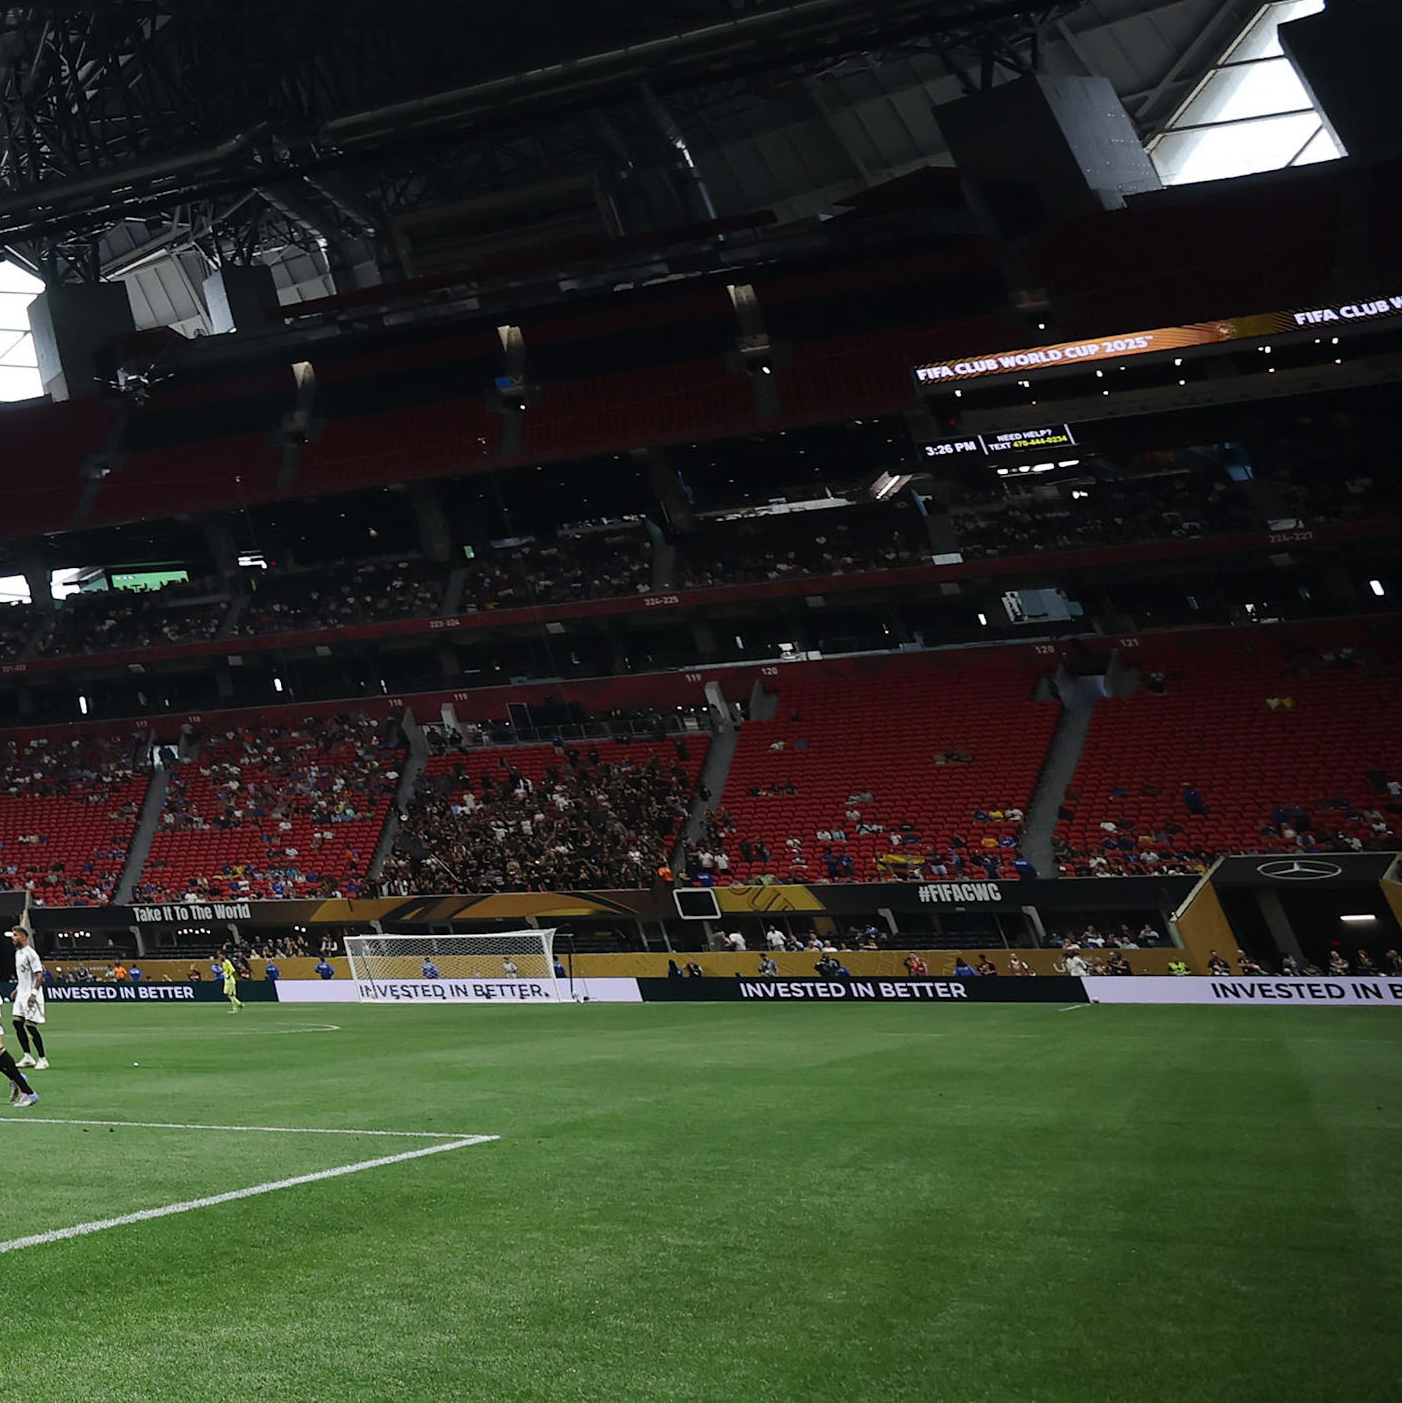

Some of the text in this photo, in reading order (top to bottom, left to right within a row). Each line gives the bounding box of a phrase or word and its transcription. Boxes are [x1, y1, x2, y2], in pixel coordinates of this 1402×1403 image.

[1294, 309, 1338, 324] FIFA
[1339, 300, 1389, 317] CLUB
[916, 365, 953, 379] FIFA
[954, 359, 997, 374] CLUB
[998, 349, 1062, 367] WORLD
[1063, 343, 1100, 358] CUP
[925, 441, 977, 456] 3:26 PM
[919, 883, 1000, 901] #FIFACWC
[133, 902, 252, 922] Take It To The World
[47, 986, 193, 999] INVESTED IN BETTER
[360, 984, 542, 998] INVESTED IN BETTER
[740, 982, 966, 997] INVESTED IN BETTER
[1212, 982, 1344, 998] INVESTED
[1351, 983, 1382, 998] IN
